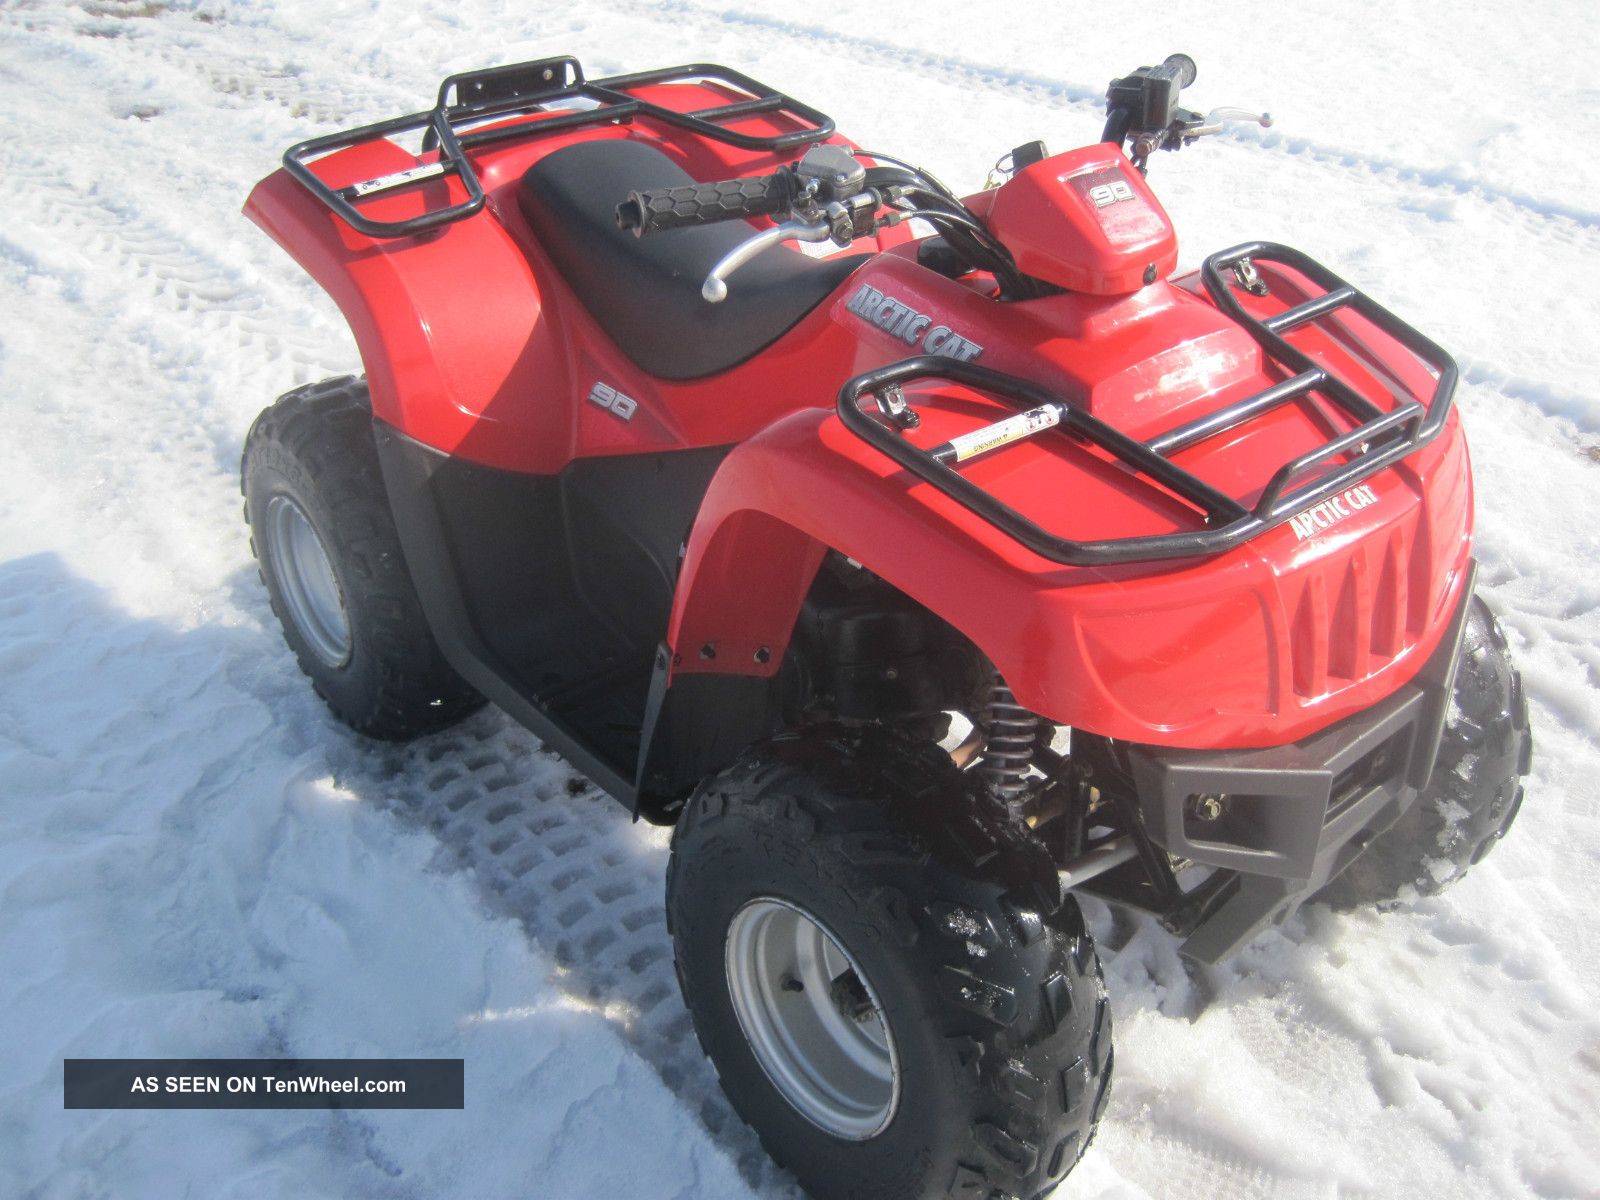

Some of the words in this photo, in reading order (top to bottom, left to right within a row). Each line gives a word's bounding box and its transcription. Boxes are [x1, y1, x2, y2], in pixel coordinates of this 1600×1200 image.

[1090, 180, 1135, 209] 90
[847, 283, 933, 346] ARCTIC
[922, 325, 984, 362] CAT
[588, 381, 638, 421] 90
[1289, 496, 1351, 541] ARCTIC
[1344, 484, 1379, 510] CAT
